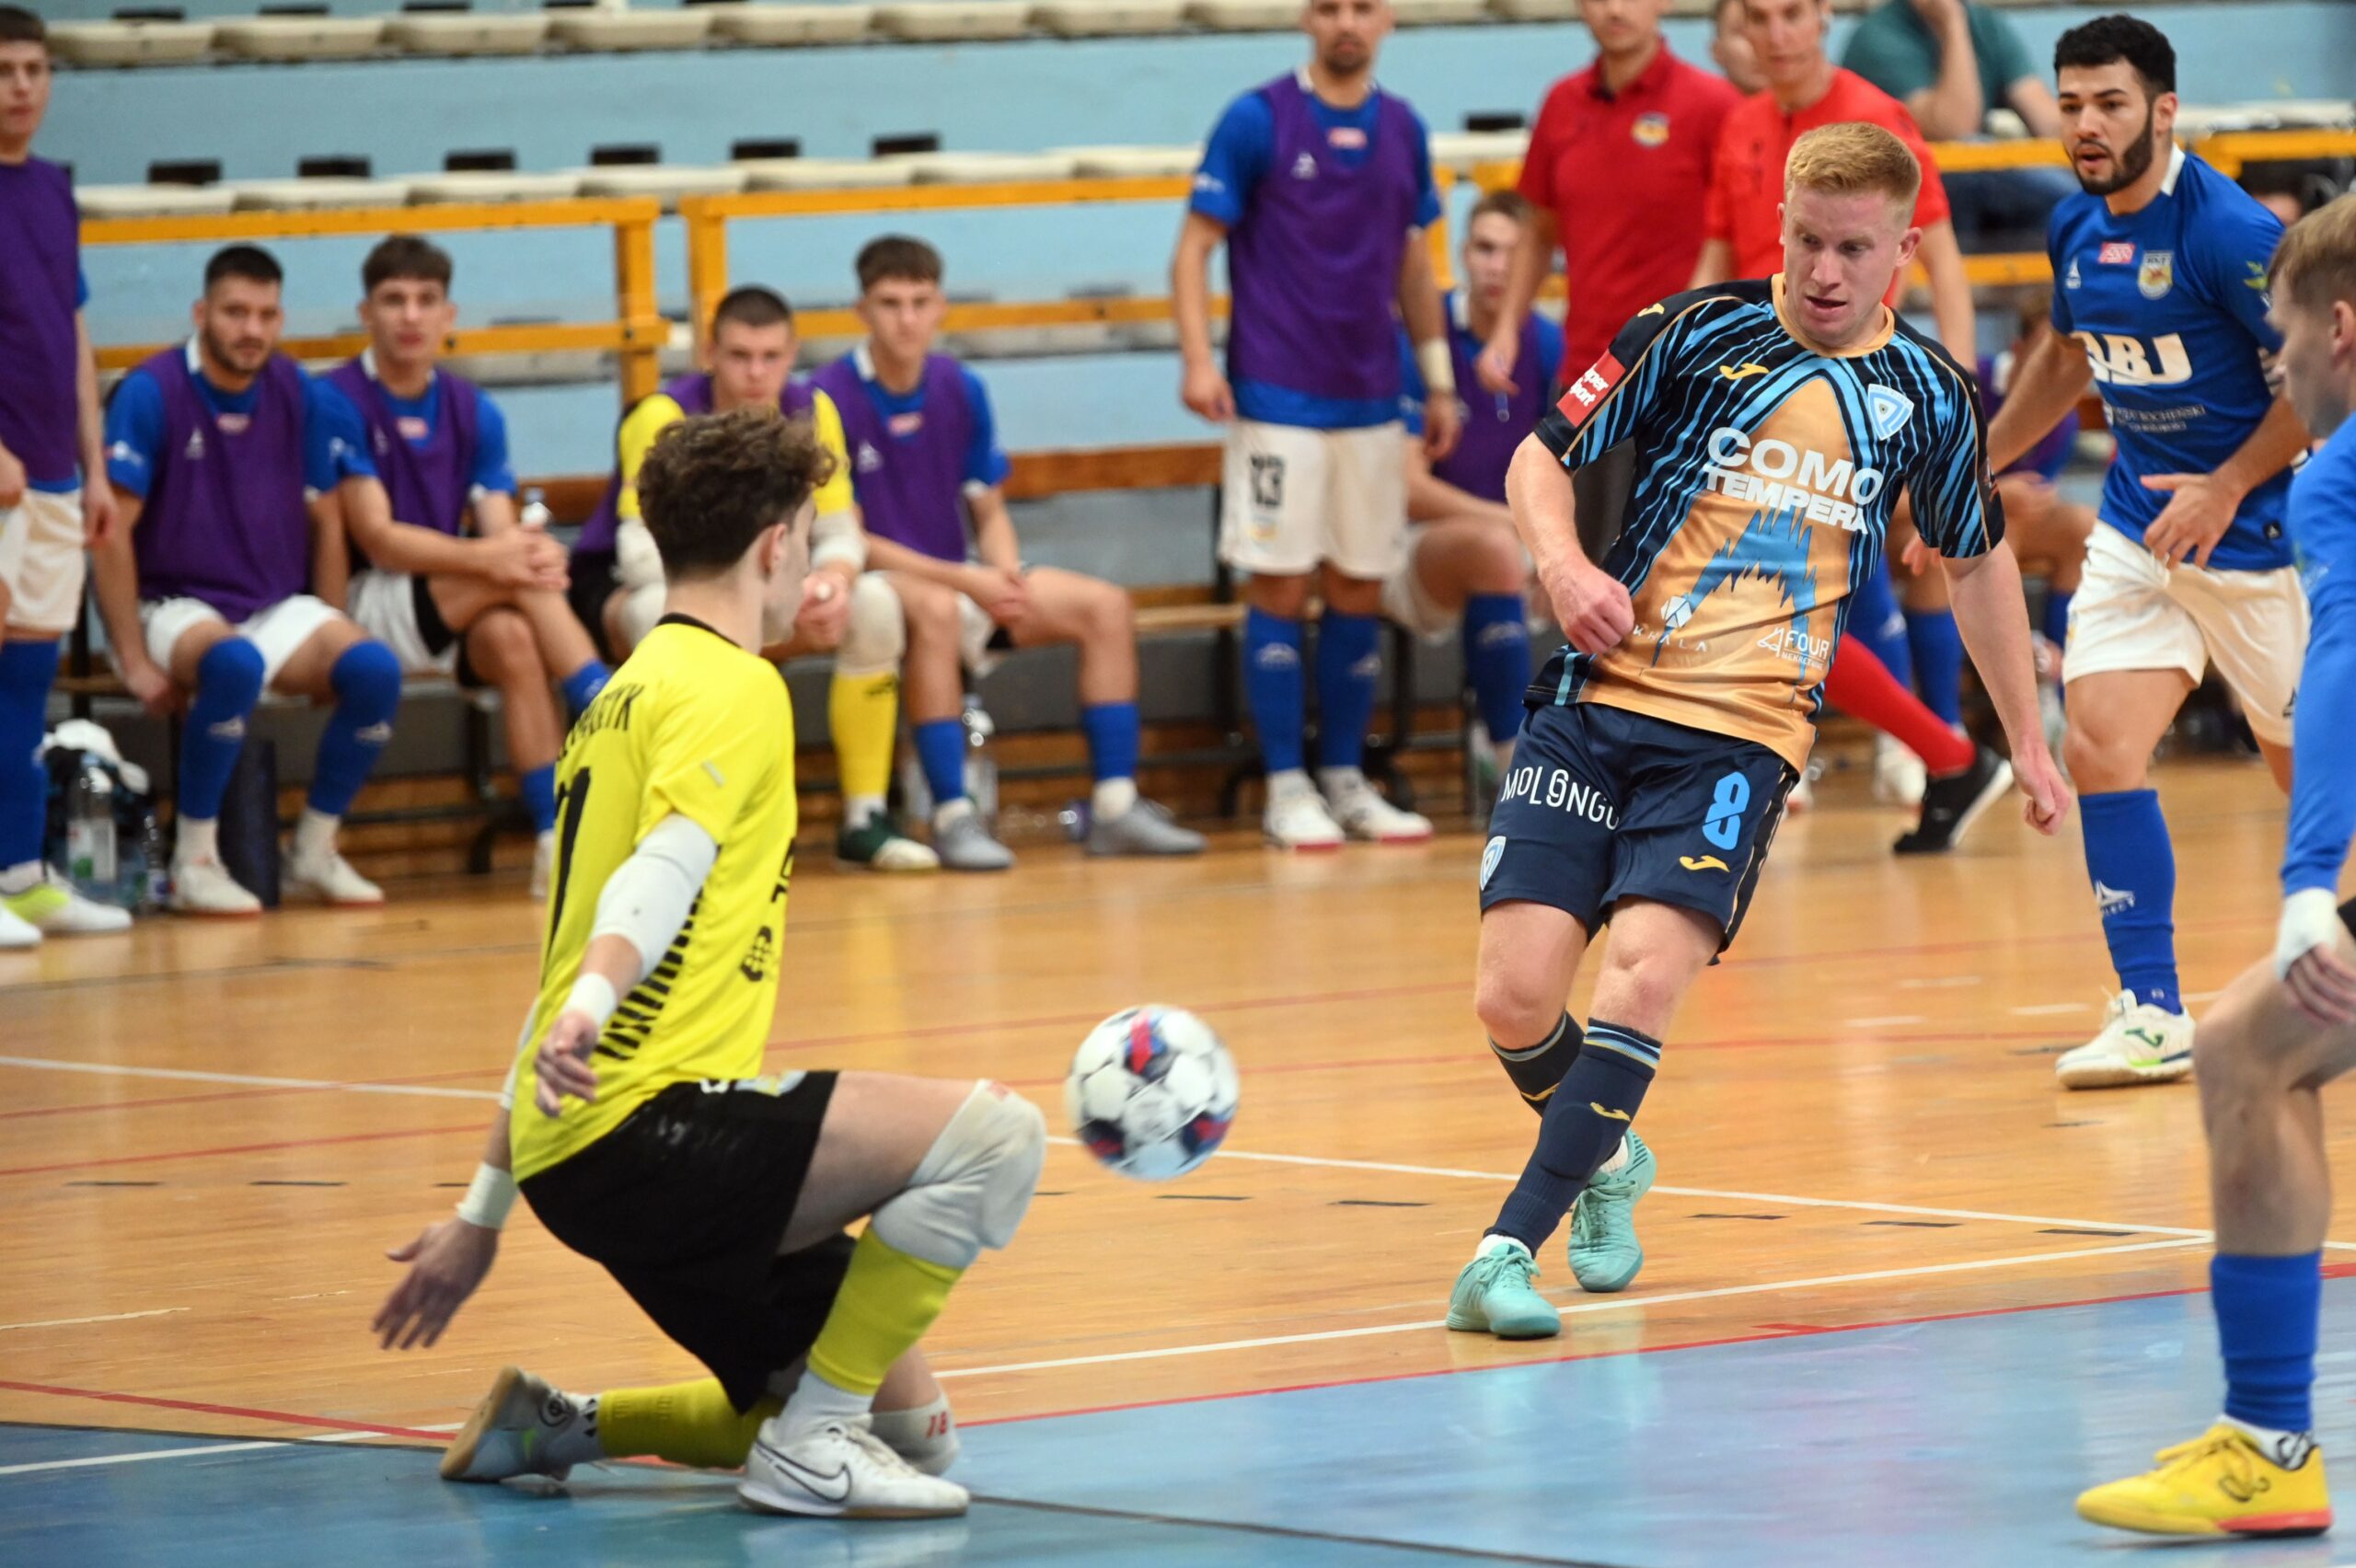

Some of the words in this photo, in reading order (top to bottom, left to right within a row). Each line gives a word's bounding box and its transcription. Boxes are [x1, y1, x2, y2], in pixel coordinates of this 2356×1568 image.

[1703, 462, 1868, 535] TEMPERA
[1707, 426, 1884, 505] COMO
[1784, 629, 1830, 661] FOUR
[1702, 771, 1750, 850] 8
